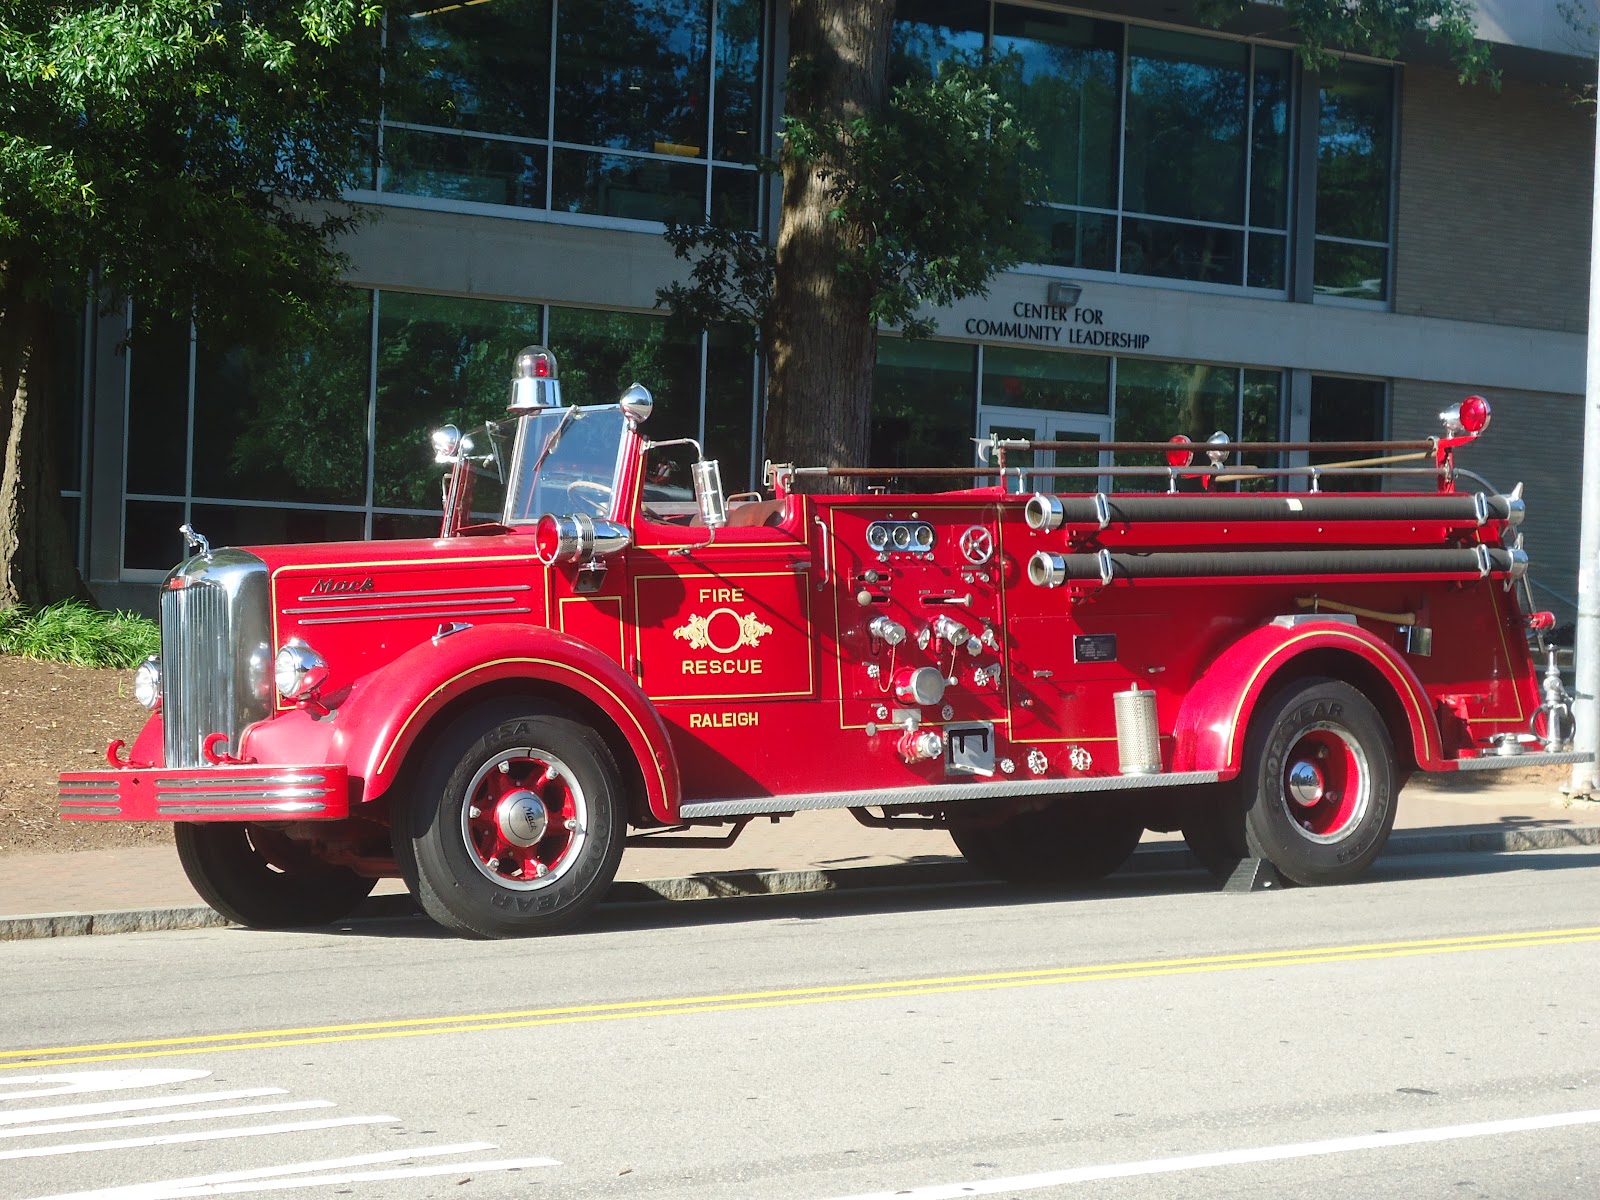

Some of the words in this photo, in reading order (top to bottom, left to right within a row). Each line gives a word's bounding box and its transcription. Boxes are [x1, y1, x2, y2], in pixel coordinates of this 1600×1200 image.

[1013, 301, 1067, 322] CENTER
[1075, 307, 1103, 325] FOR
[965, 318, 1062, 342] COMMUNITY
[1069, 328, 1150, 349] LEADERSHIP
[311, 577, 373, 593] Mack
[699, 588, 744, 603] FIRE
[682, 659, 763, 675] RESCUE
[689, 711, 759, 728] RALEIGH
[523, 806, 537, 833] Mack
